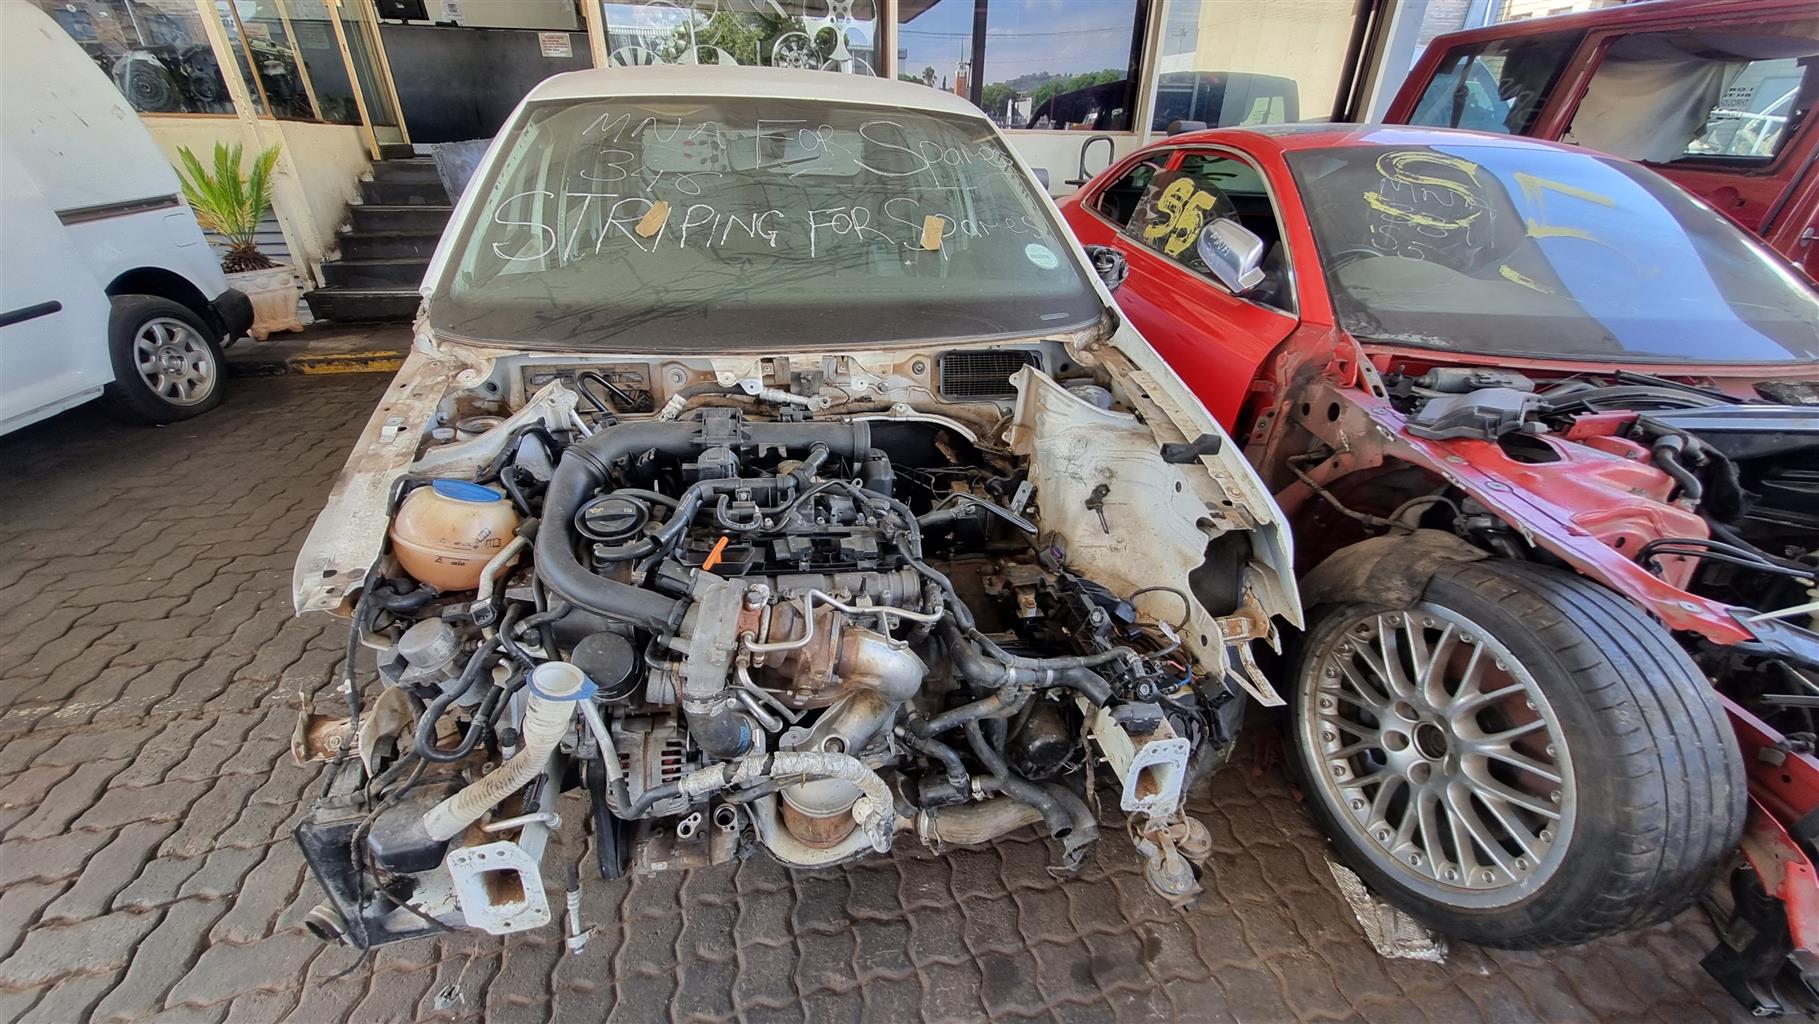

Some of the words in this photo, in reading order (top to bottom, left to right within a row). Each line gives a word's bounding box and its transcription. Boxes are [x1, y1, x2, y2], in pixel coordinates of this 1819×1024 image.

[582, 112, 727, 149] MNA
[756, 118, 851, 169] FOR
[492, 190, 785, 261] STRIPING
[807, 206, 894, 258] FOR
